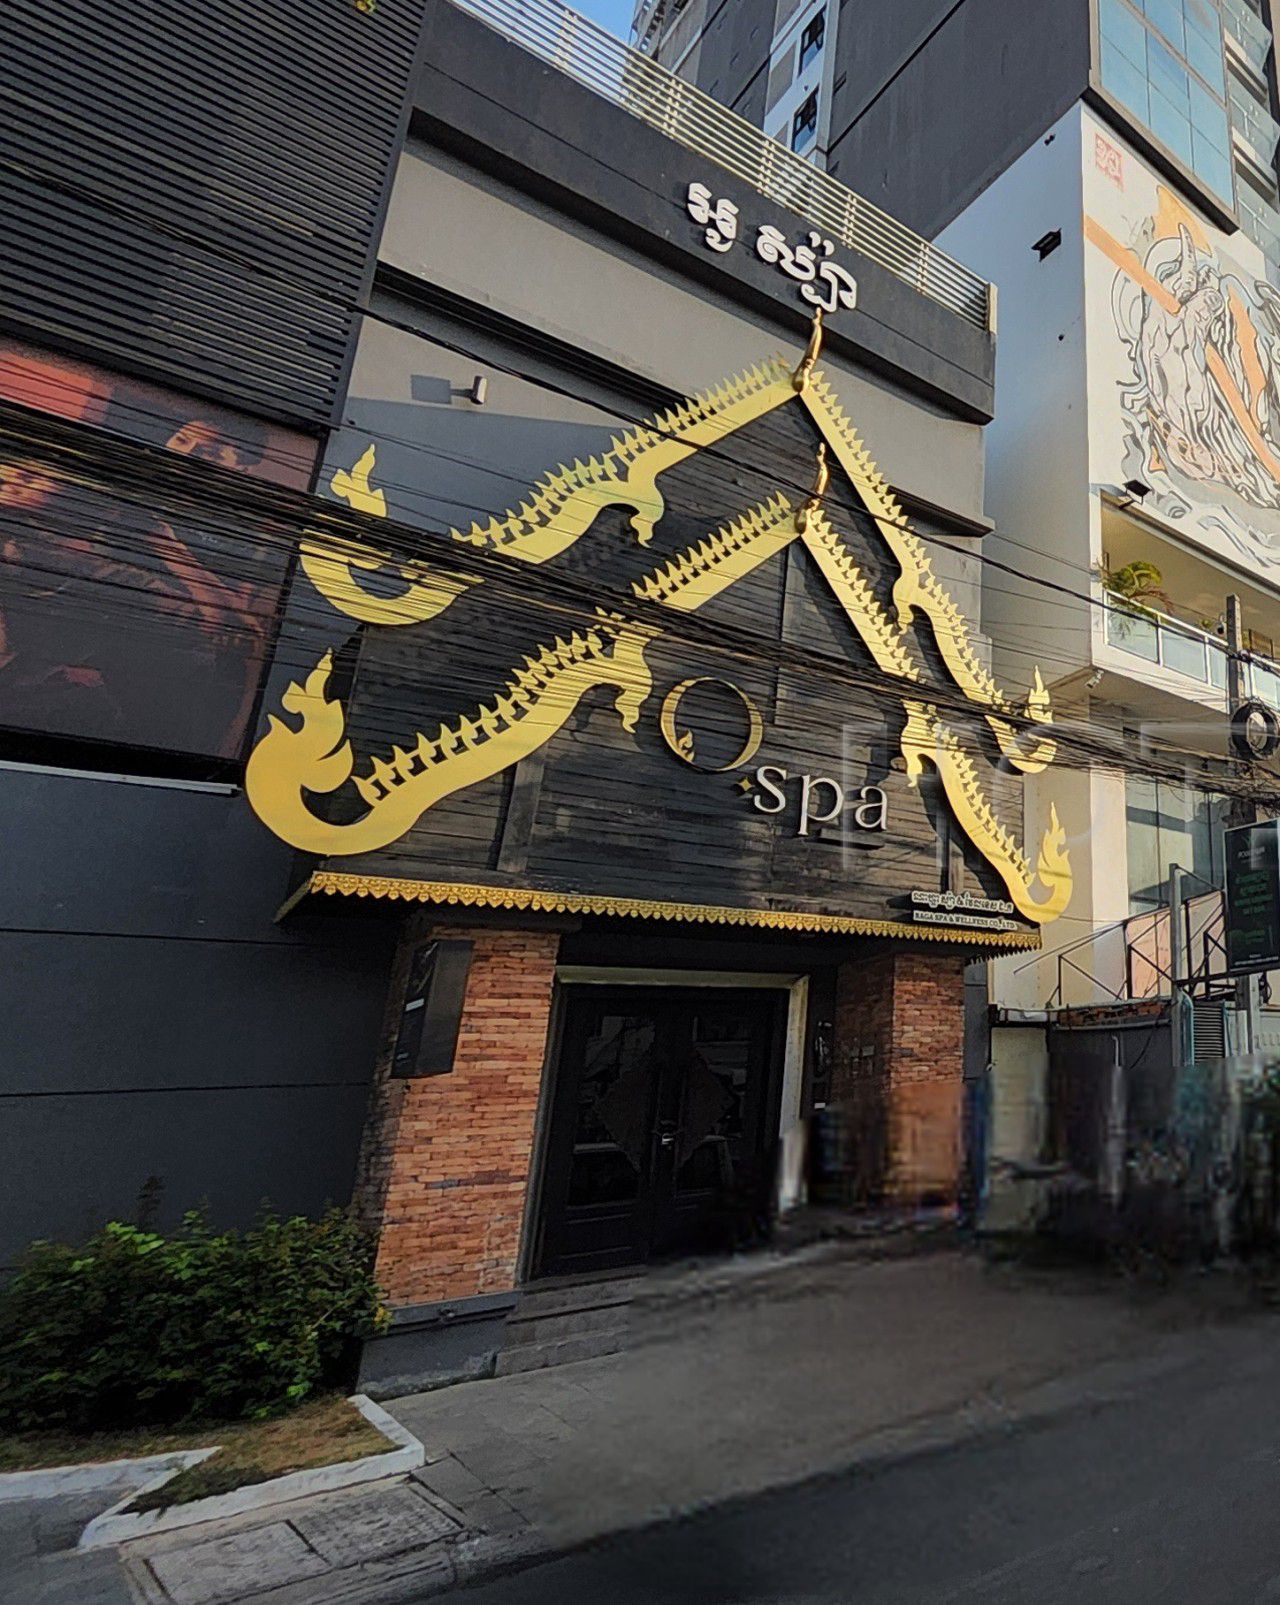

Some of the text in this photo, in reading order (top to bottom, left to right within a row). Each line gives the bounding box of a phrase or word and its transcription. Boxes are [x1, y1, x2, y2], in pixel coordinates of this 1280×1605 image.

[660, 677, 888, 836] O spa
[934, 913, 948, 923] SPA
